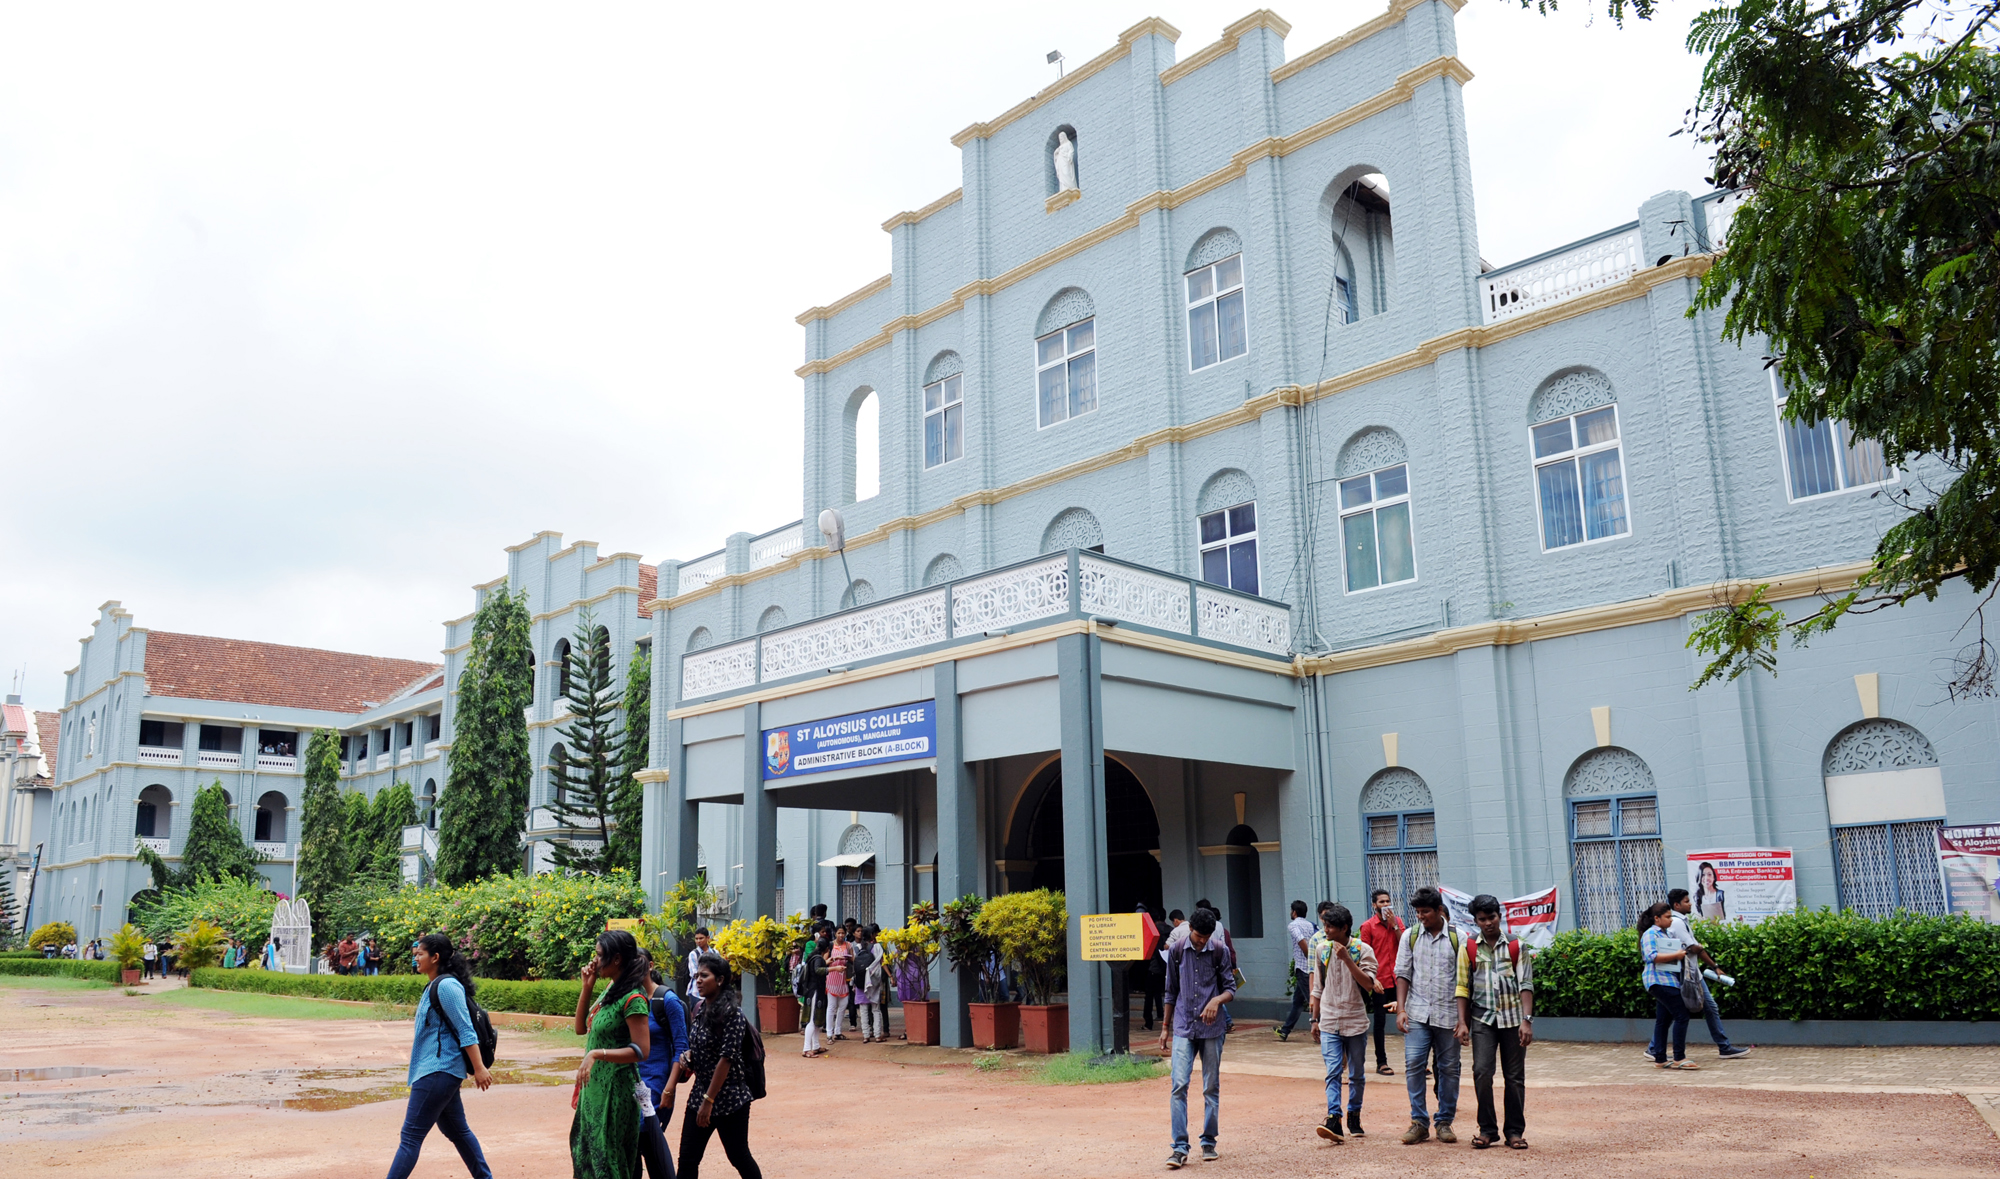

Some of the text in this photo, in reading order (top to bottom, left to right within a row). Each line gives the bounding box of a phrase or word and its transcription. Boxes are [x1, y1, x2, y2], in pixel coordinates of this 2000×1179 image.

[797, 708, 925, 742] ST ALOYSIUS COLLEGE
[863, 728, 901, 742] MANGALURU
[797, 740, 925, 766] ADMINISTRATIVE BLOCK (A-BLOCK)
[1944, 828, 1983, 839] HOME
[1964, 838, 2000, 847] Aloysius
[1513, 903, 1552, 916] CAT 2017
